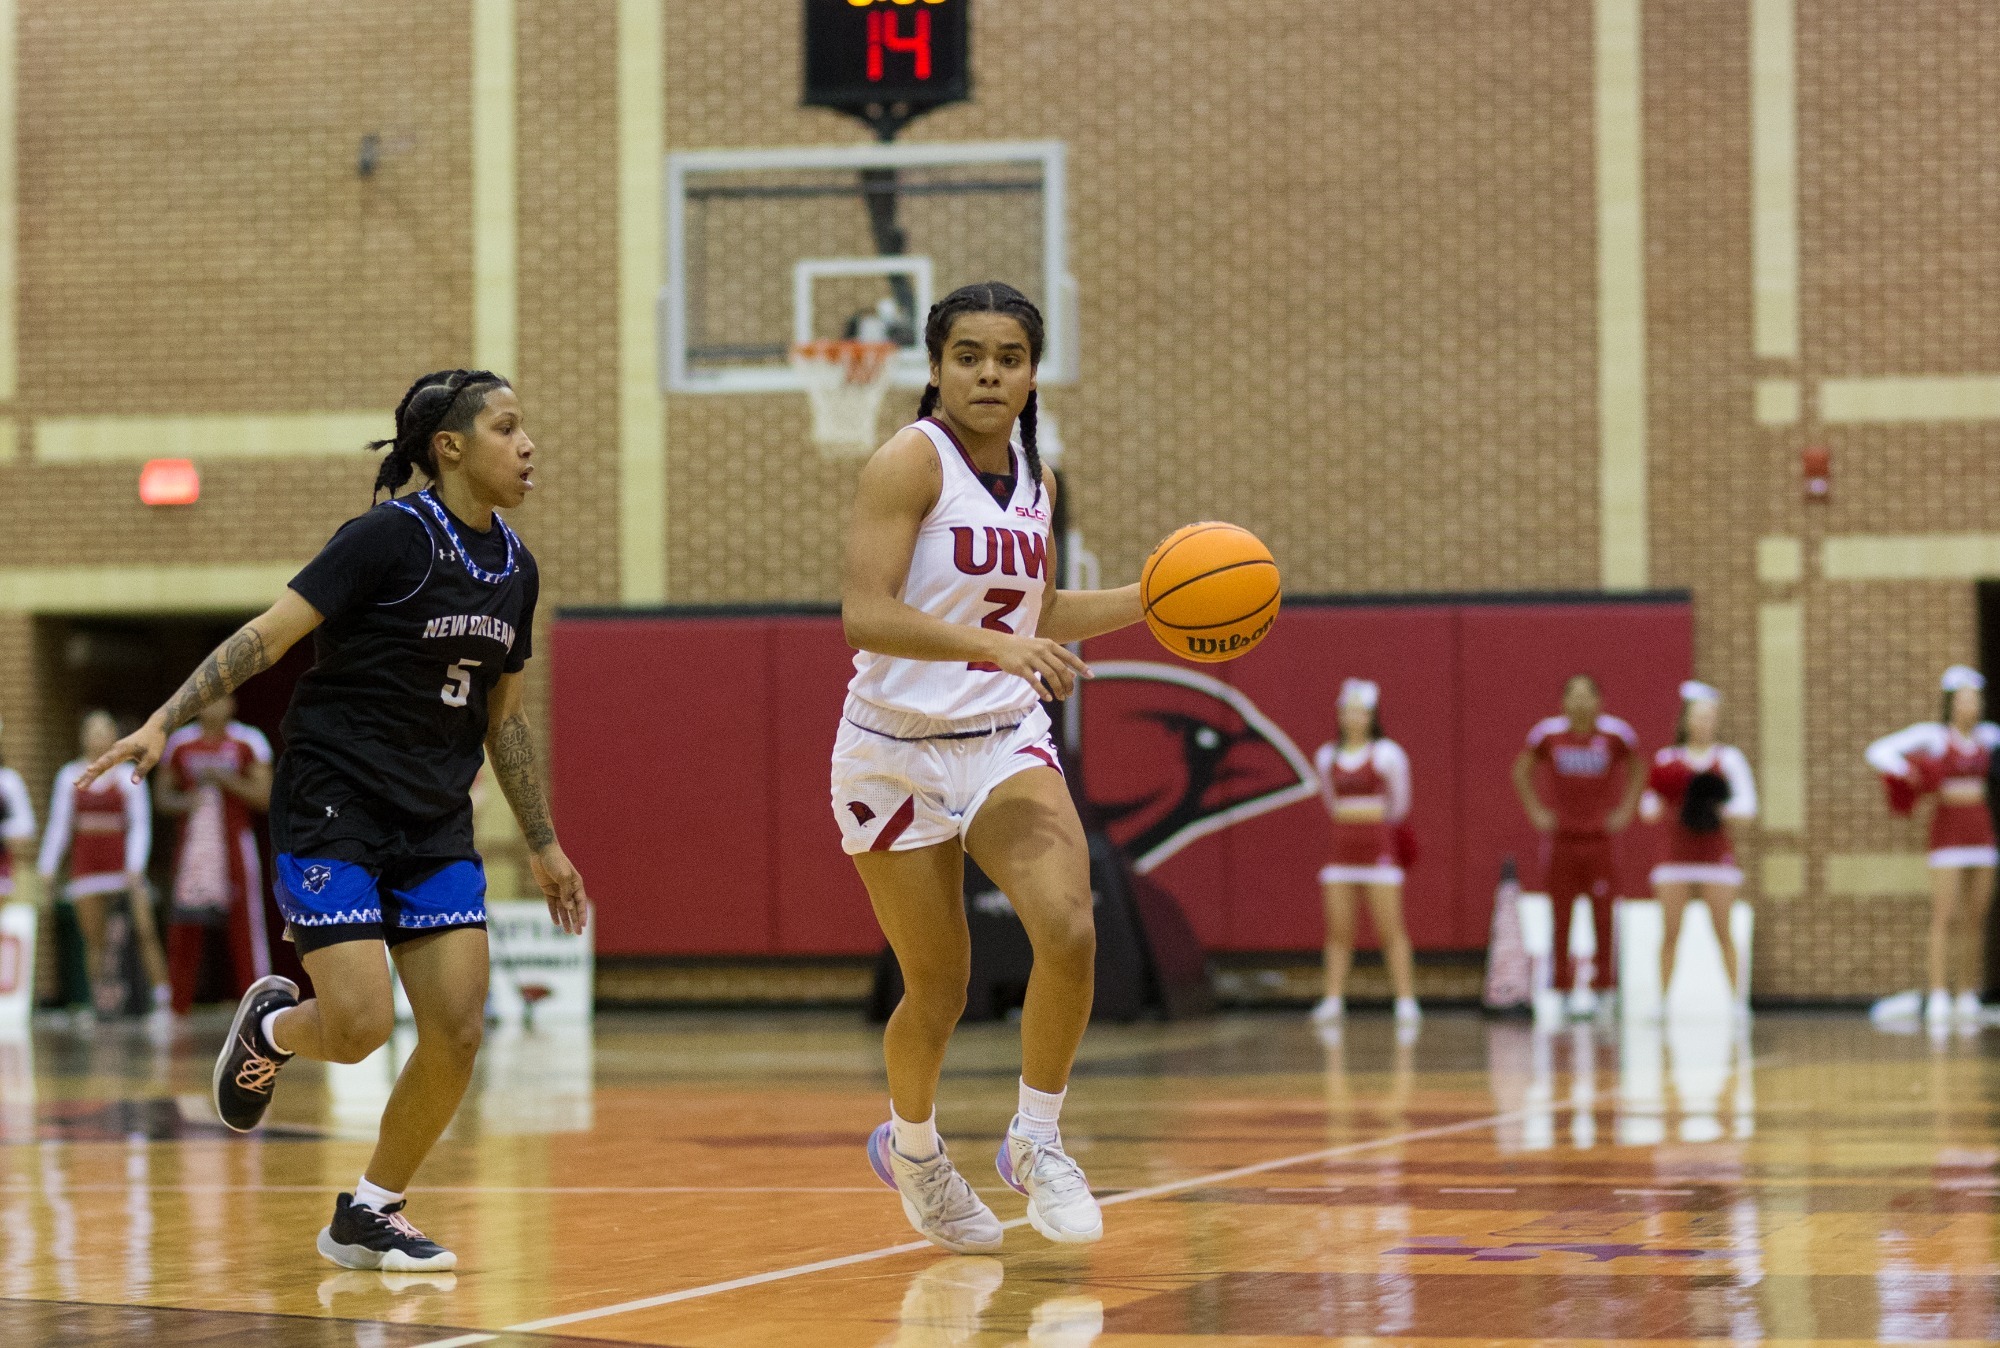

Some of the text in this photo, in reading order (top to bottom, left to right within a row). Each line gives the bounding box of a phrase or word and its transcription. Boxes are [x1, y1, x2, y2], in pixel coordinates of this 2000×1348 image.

[866, 8, 931, 81] 14
[949, 526, 1047, 582] UIW
[421, 614, 468, 639] NEW
[966, 587, 1027, 672] 3
[440, 658, 482, 708] 5
